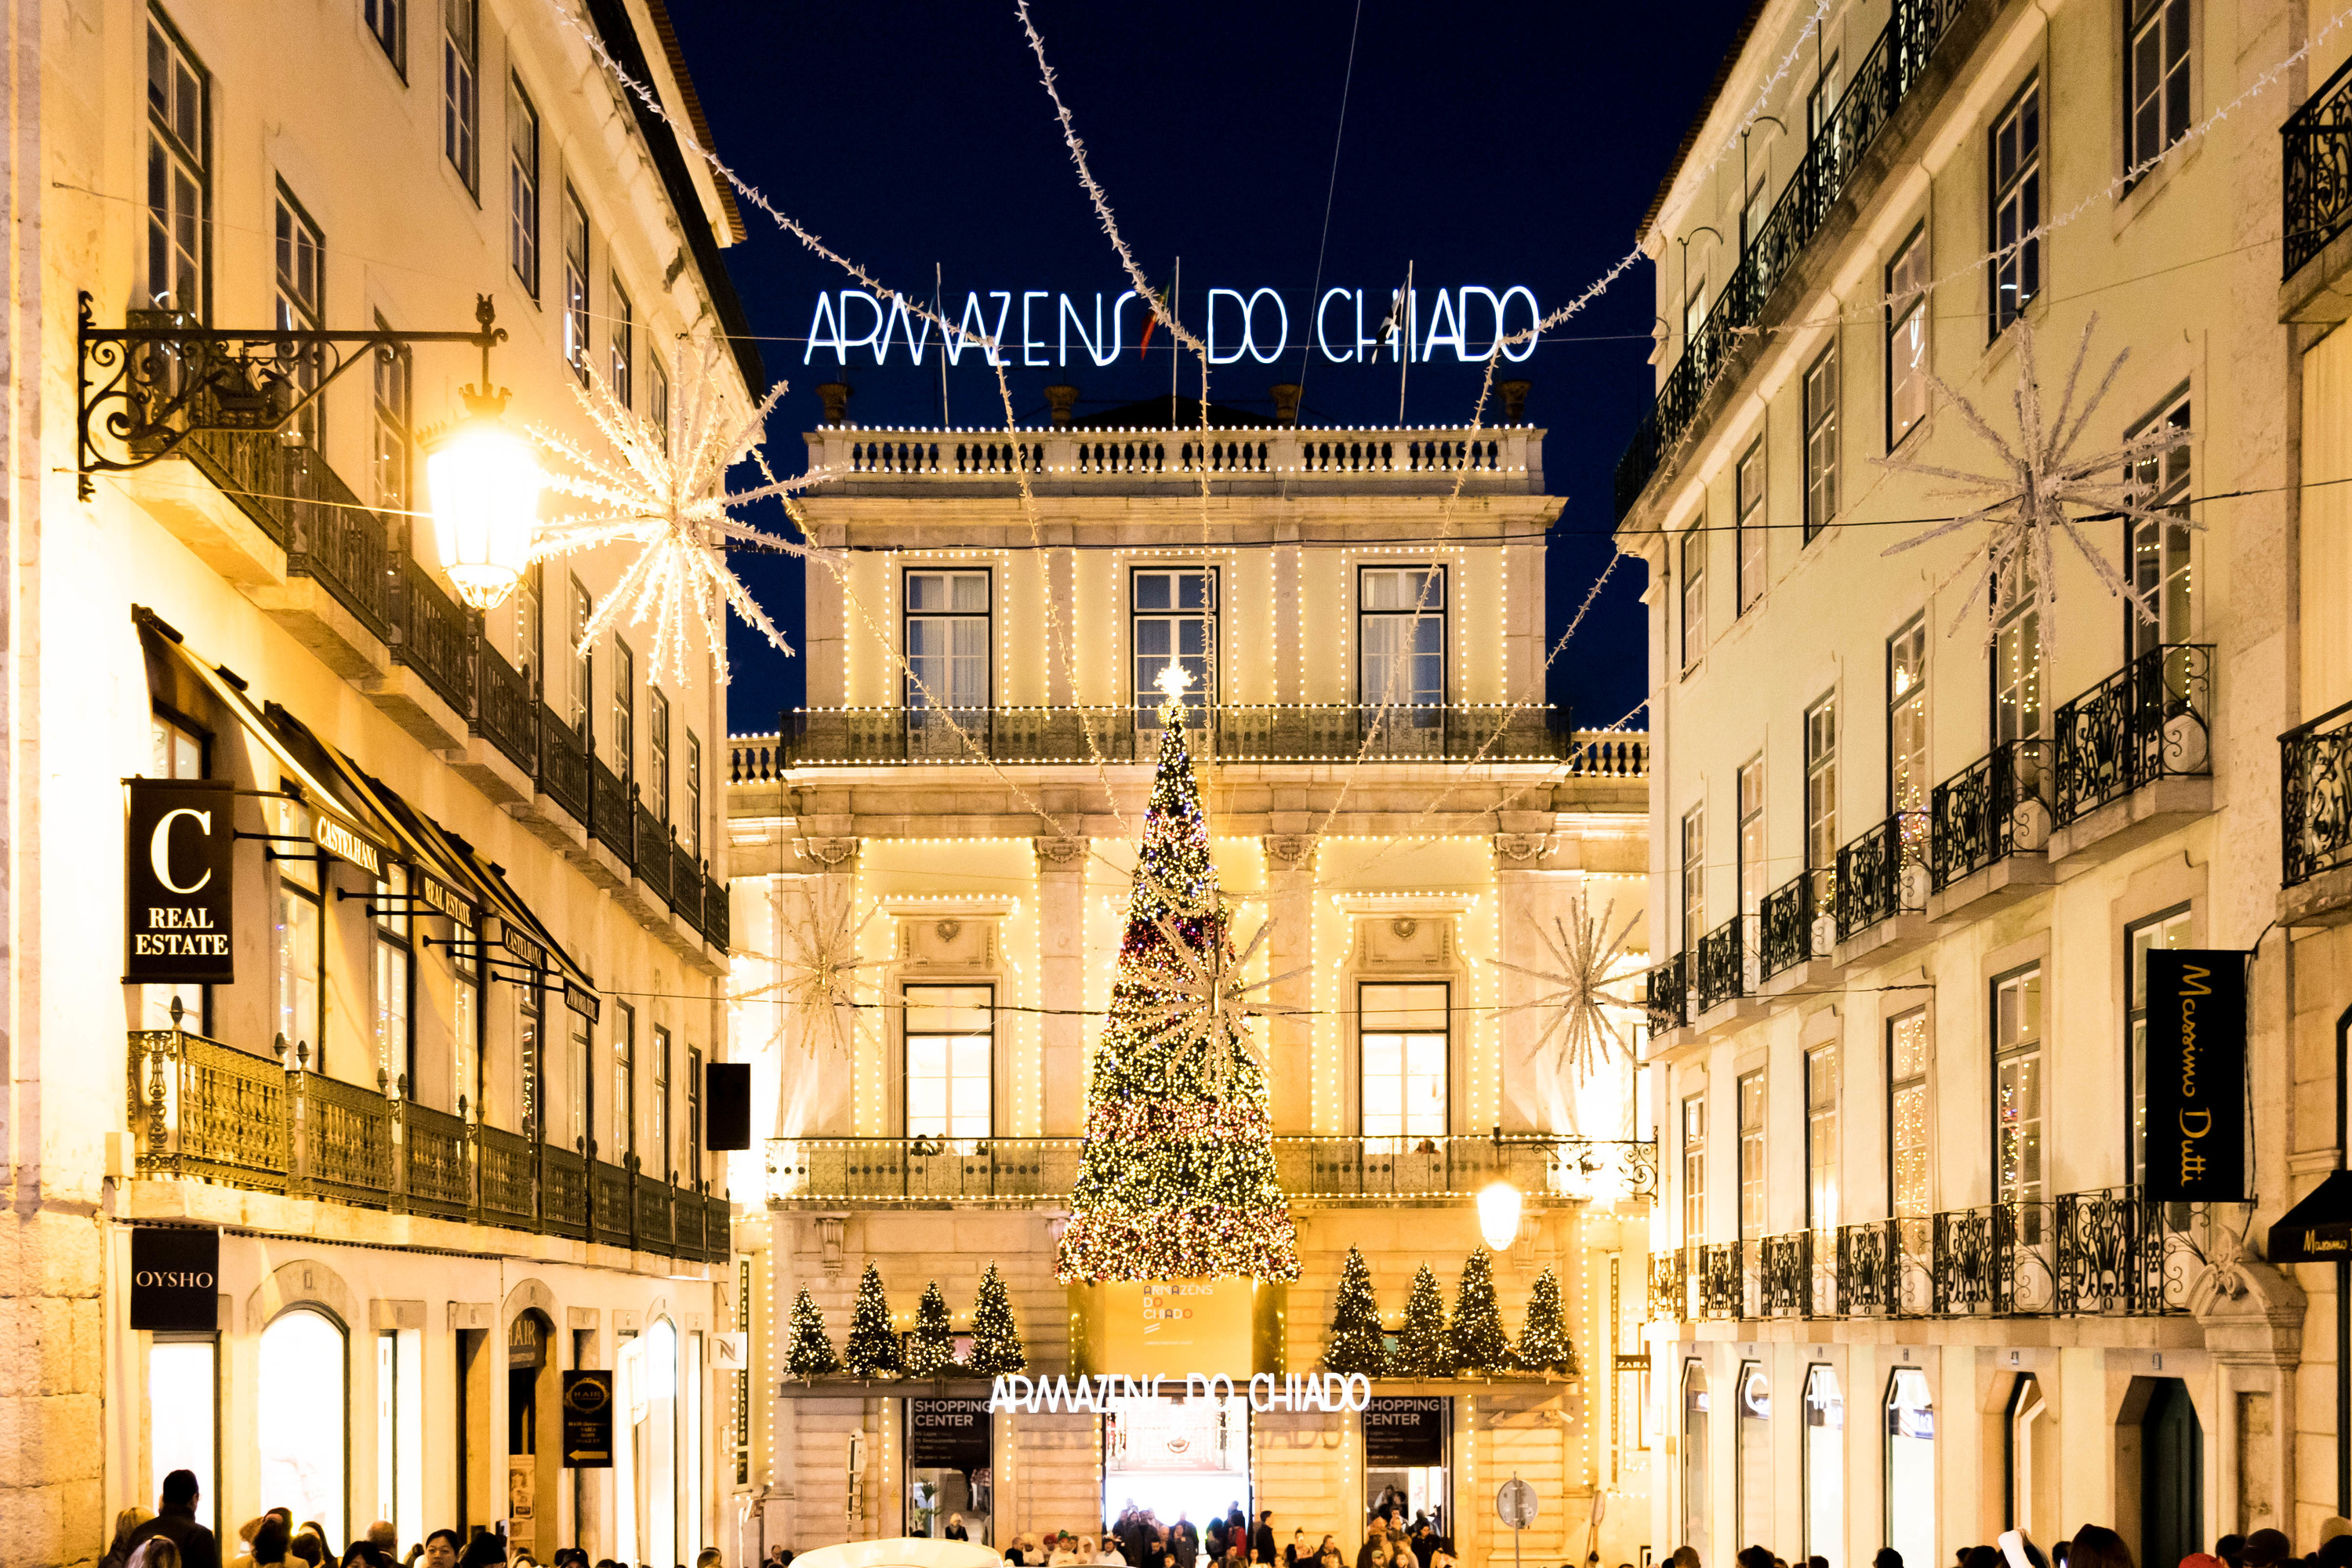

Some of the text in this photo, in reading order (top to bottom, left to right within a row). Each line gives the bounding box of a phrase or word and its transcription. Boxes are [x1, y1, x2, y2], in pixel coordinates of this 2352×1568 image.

[804, 285, 1540, 367] ARMAZENS DO CHIADO
[151, 808, 212, 895] C
[317, 816, 381, 877] CASTELHANA
[425, 877, 473, 928] REAL ESTATE
[149, 908, 214, 930] REAL
[135, 935, 229, 956] ESTATE
[2178, 964, 2212, 1187] Massimo Dutti
[136, 1271, 213, 1288] OYSHO
[1143, 1282, 1214, 1295] ARMAZÉNS
[1143, 1297, 1163, 1308] DO
[1143, 1308, 1193, 1319] CHIADO
[1249, 1372, 1372, 1412] CHIADO
[915, 1400, 991, 1412] SHOPPING
[915, 1414, 974, 1426] CENTER
[1365, 1414, 1421, 1425] CENTER
